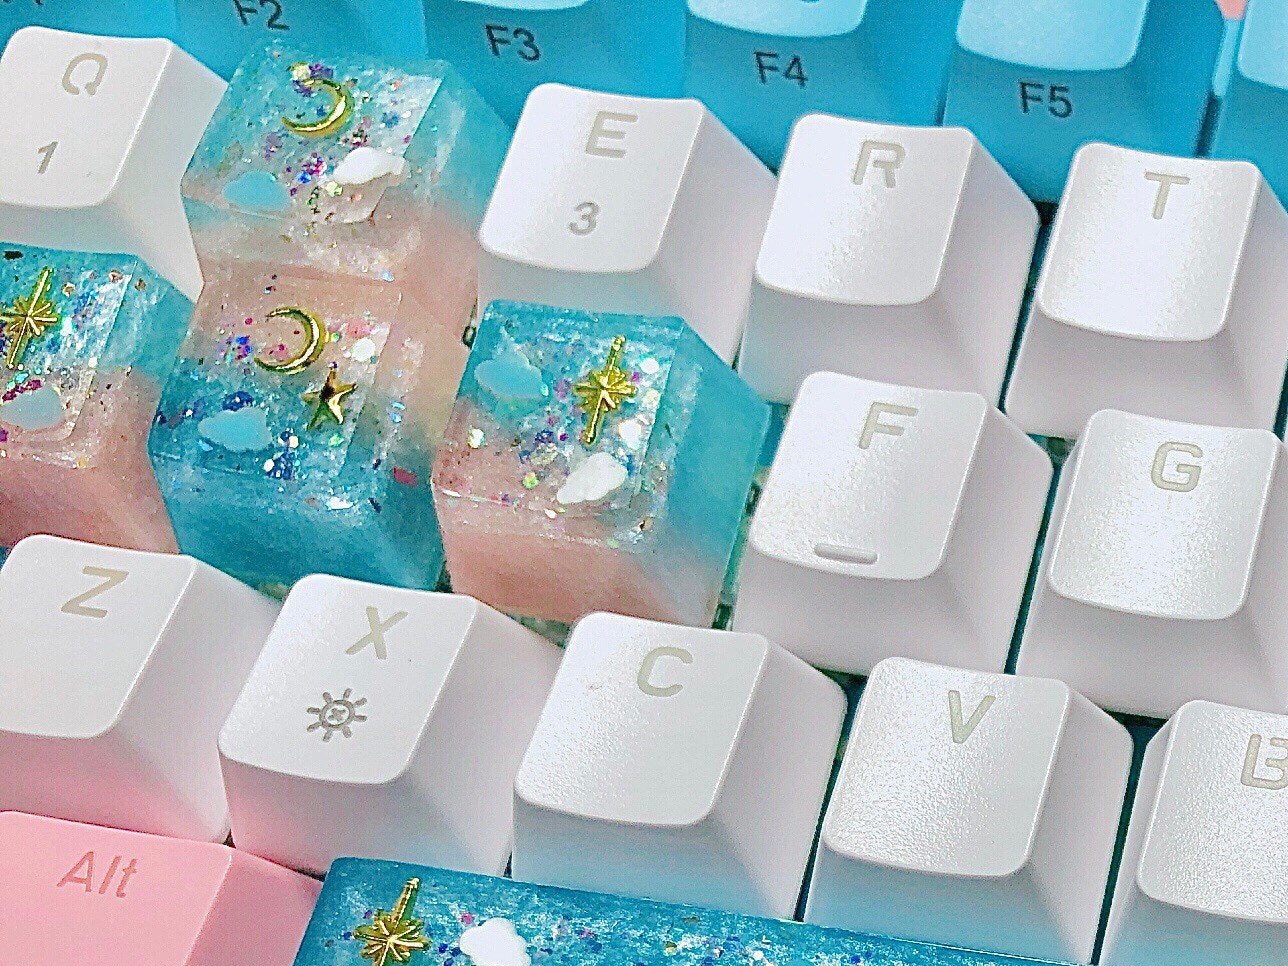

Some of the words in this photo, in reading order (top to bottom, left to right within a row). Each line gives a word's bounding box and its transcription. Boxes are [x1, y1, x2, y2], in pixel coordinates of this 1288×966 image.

[233, 0, 291, 30] F2
[485, 25, 540, 61] F3
[754, 51, 809, 87] F4
[1019, 82, 1073, 118] F5
[585, 110, 638, 158] E
[37, 141, 59, 175] 1
[852, 140, 906, 188] R
[567, 202, 600, 236] 3
[1144, 171, 1190, 220] T
[857, 403, 918, 449] F
[1150, 441, 1204, 493] G
[60, 566, 128, 618] Z
[345, 606, 408, 660] X
[637, 645, 692, 698] C
[947, 690, 996, 744] V
[57, 851, 138, 898] Alt
